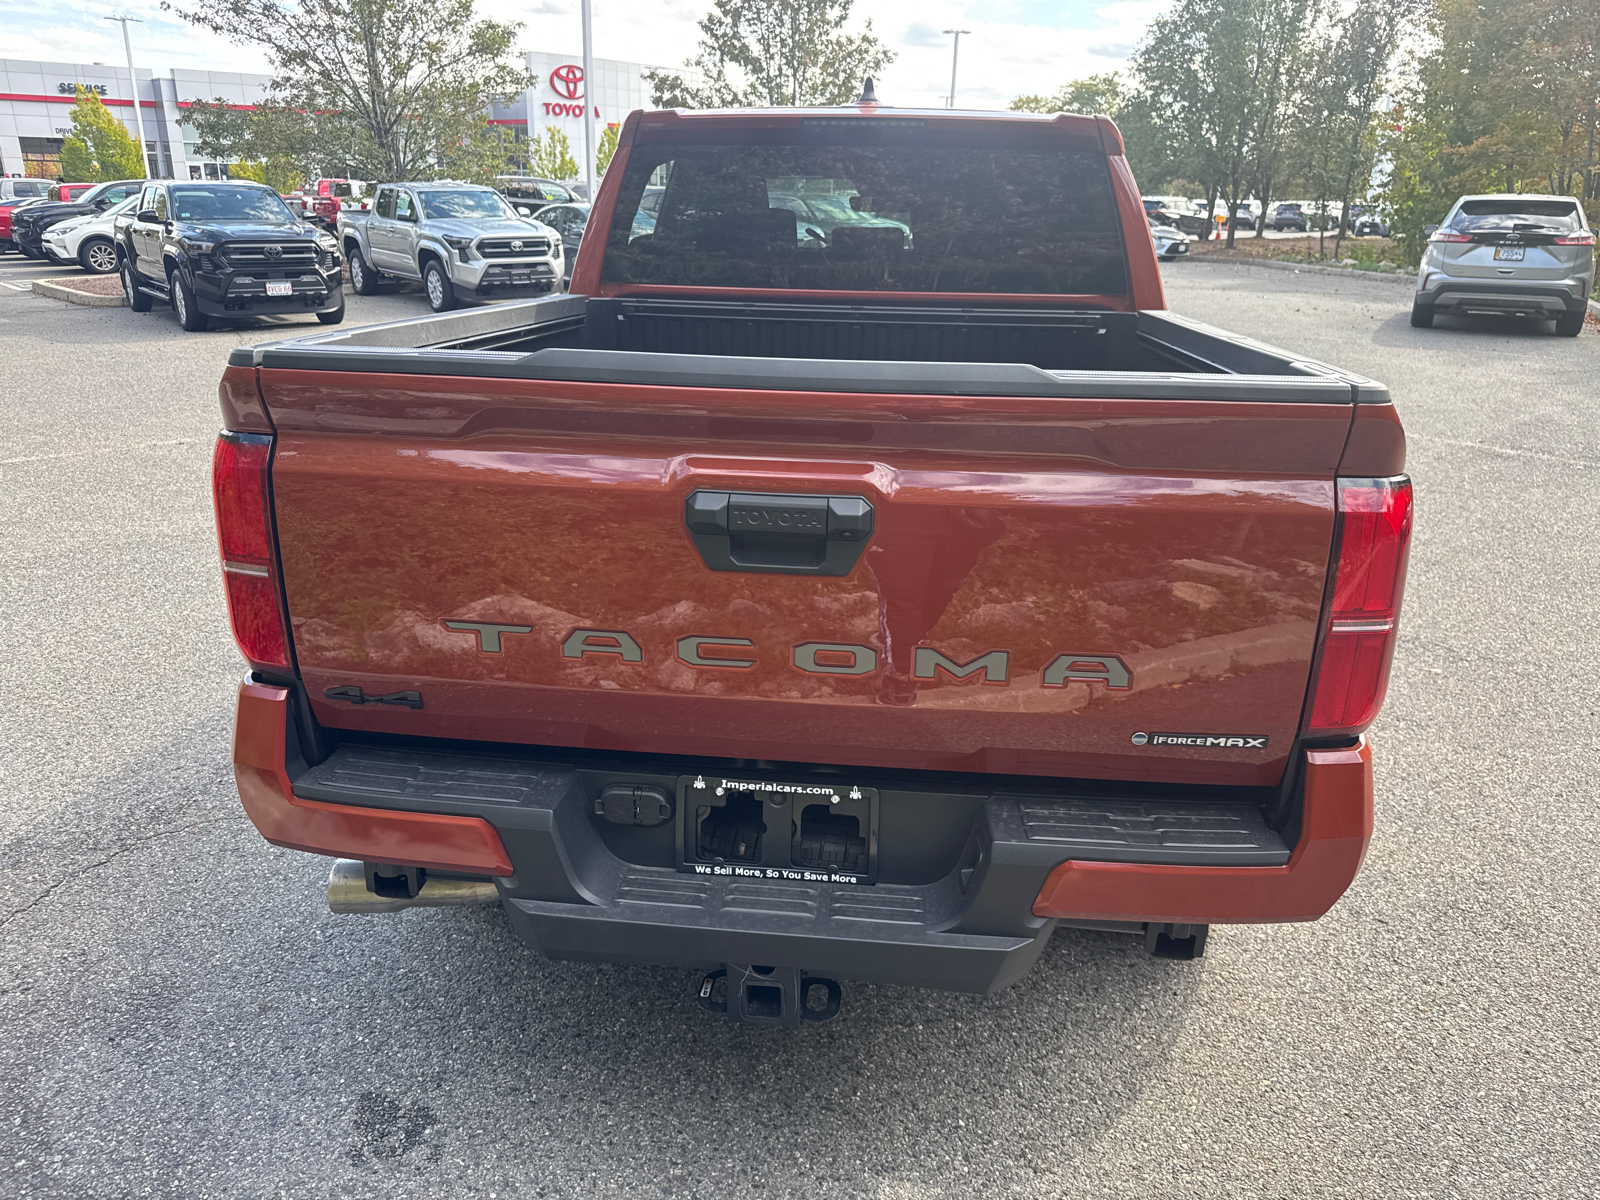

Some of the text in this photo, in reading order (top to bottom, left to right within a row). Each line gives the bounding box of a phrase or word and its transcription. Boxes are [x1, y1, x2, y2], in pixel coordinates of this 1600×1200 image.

[542, 102, 601, 118] TOYO
[733, 509, 822, 528] TOYOTA
[441, 618, 1134, 689] TACOMA
[721, 779, 834, 796] Imperialcars.com
[695, 865, 857, 884] We Sell More, So You Save More
